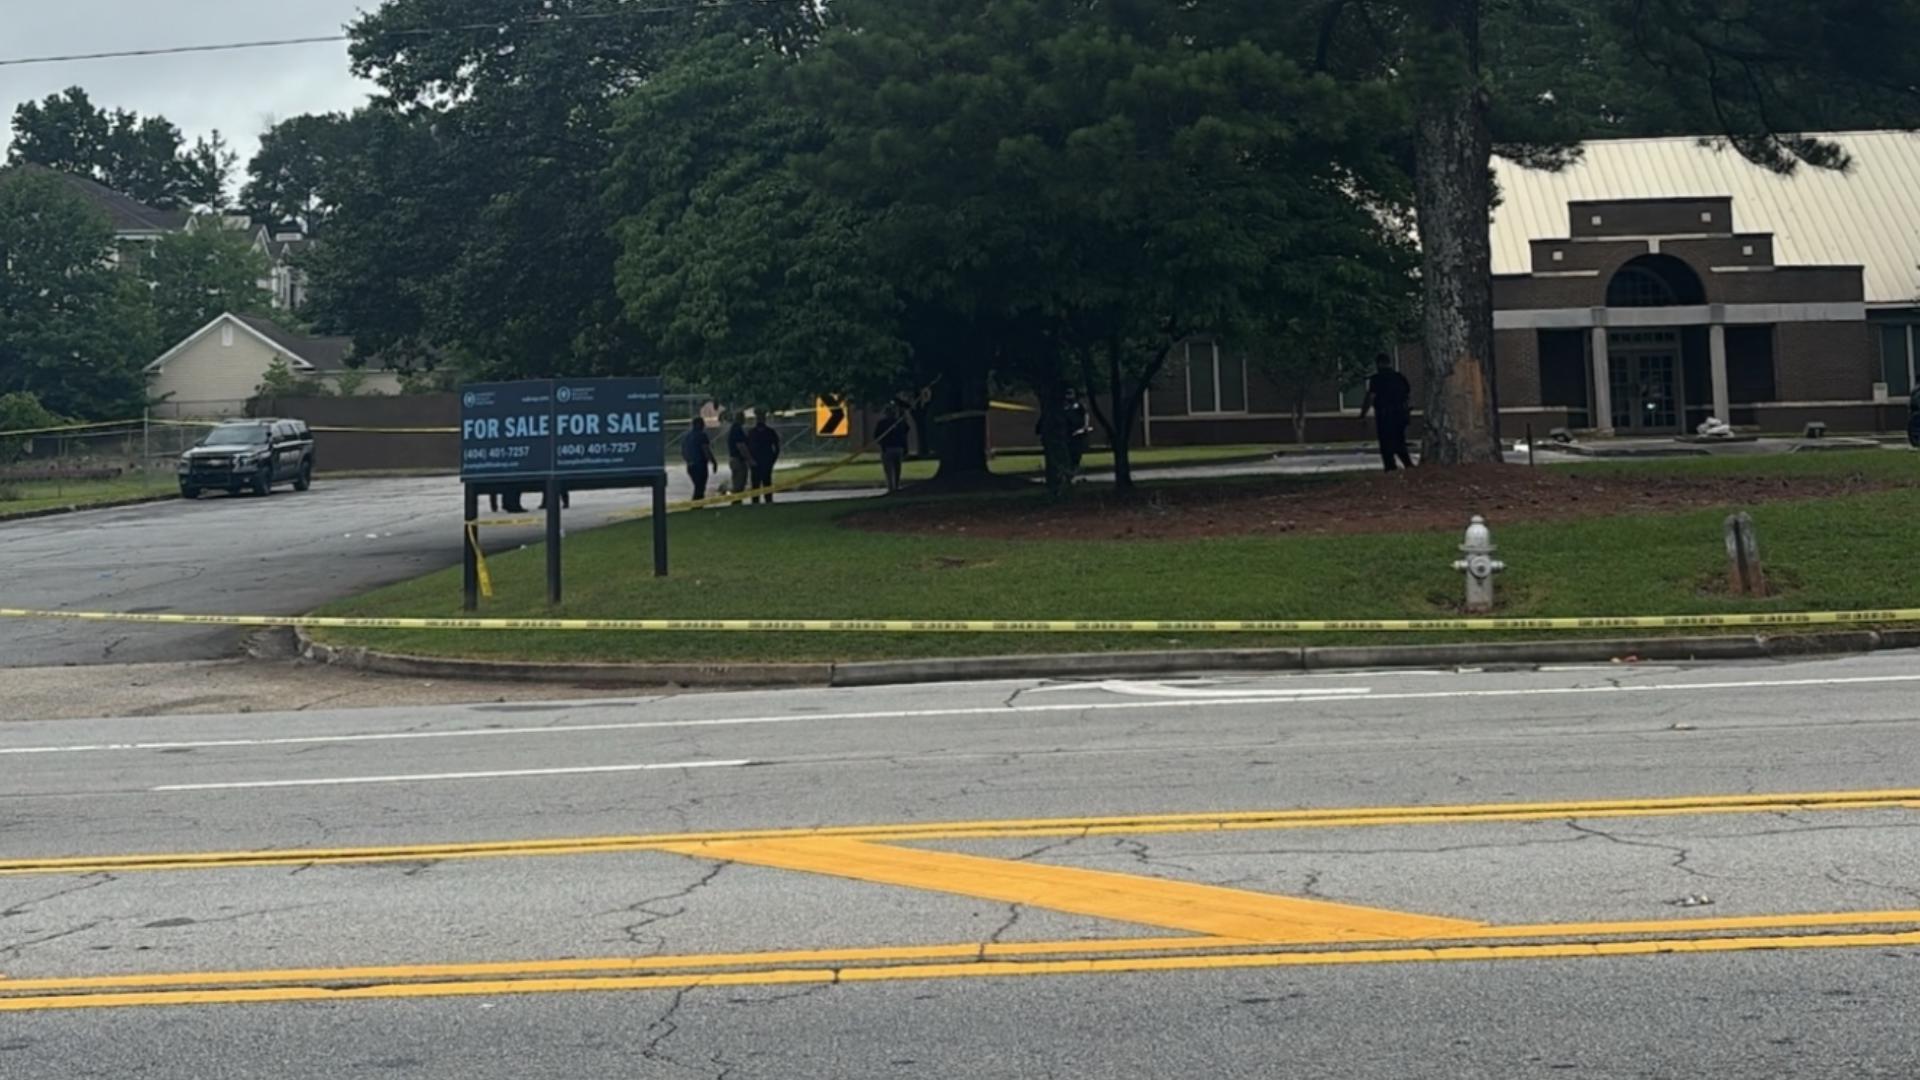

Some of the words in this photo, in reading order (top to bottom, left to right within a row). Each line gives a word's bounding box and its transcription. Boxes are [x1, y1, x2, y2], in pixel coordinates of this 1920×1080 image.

[463, 418, 499, 440] FOR
[504, 415, 550, 438] SALE
[556, 413, 600, 436] FOR
[607, 411, 660, 435] SALE
[464, 447, 487, 460] (404)
[489, 445, 530, 458] 401-7257
[557, 444, 585, 457] (404)
[587, 442, 637, 454] 401-7257
